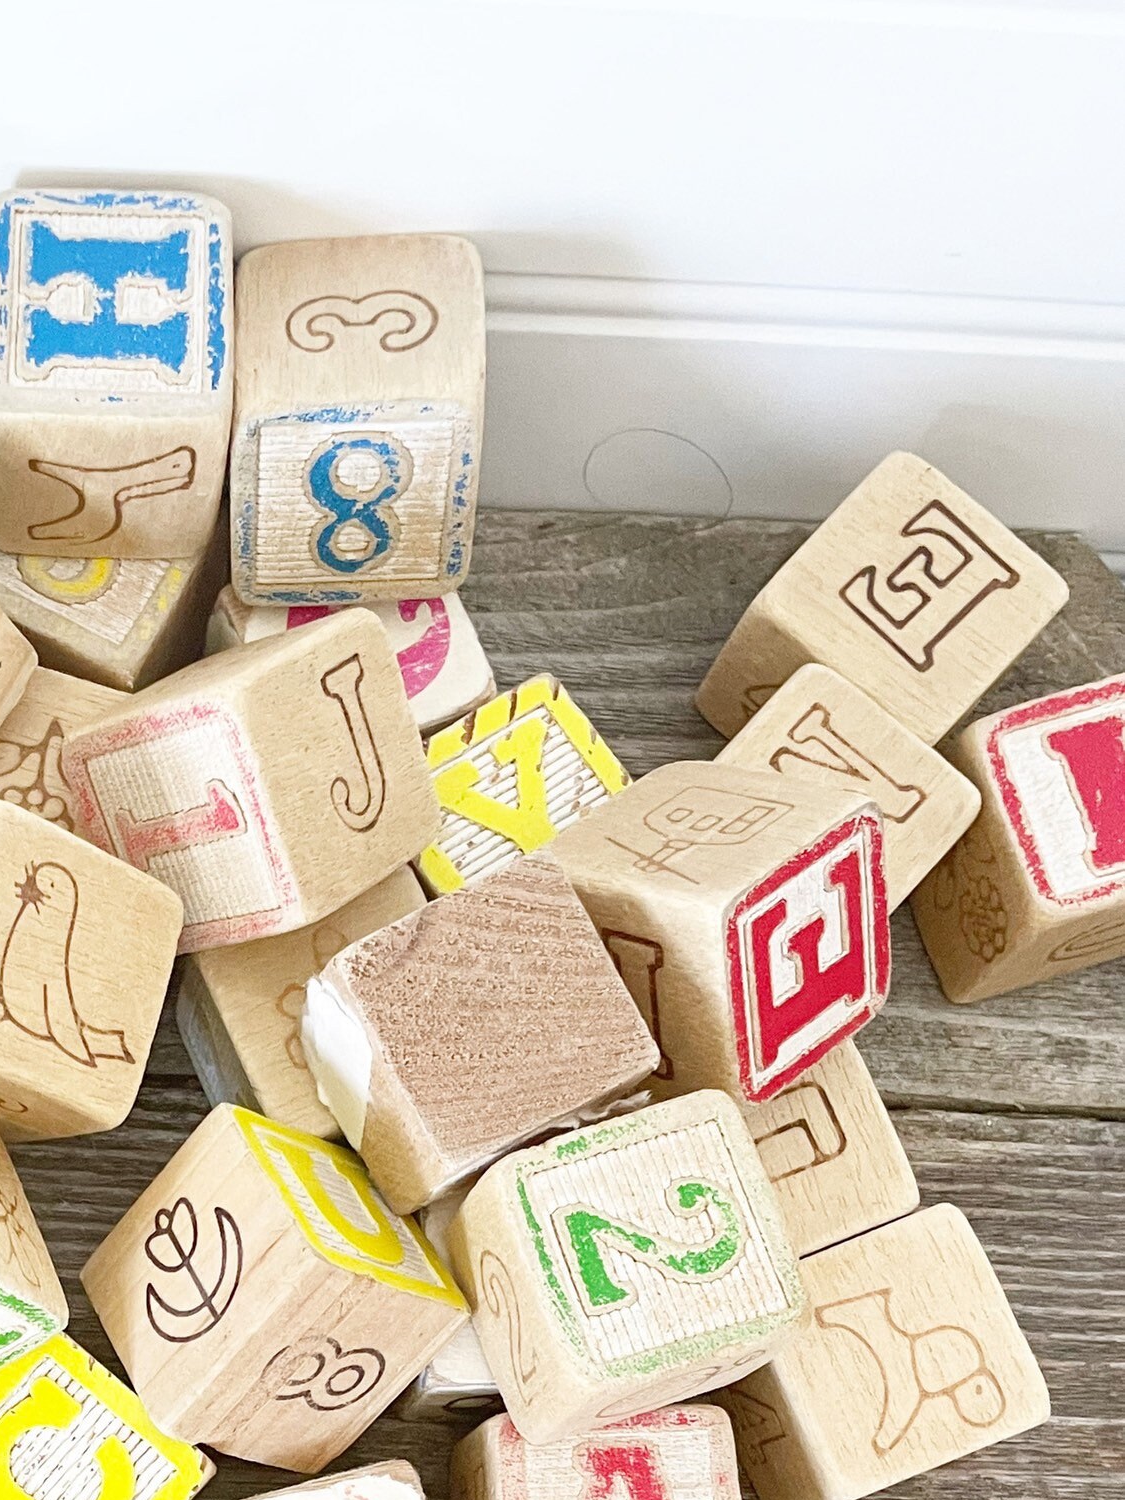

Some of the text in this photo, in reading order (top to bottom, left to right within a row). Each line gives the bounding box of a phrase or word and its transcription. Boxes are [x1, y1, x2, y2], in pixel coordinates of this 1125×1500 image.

[25, 218, 193, 375] H
[285, 289, 439, 353] 3
[305, 435, 411, 576] 8
[838, 499, 1021, 673] E
[320, 652, 387, 834] J
[751, 849, 868, 1073] E
[557, 1179, 744, 1310] 2
[261, 1335, 387, 1412] 8
